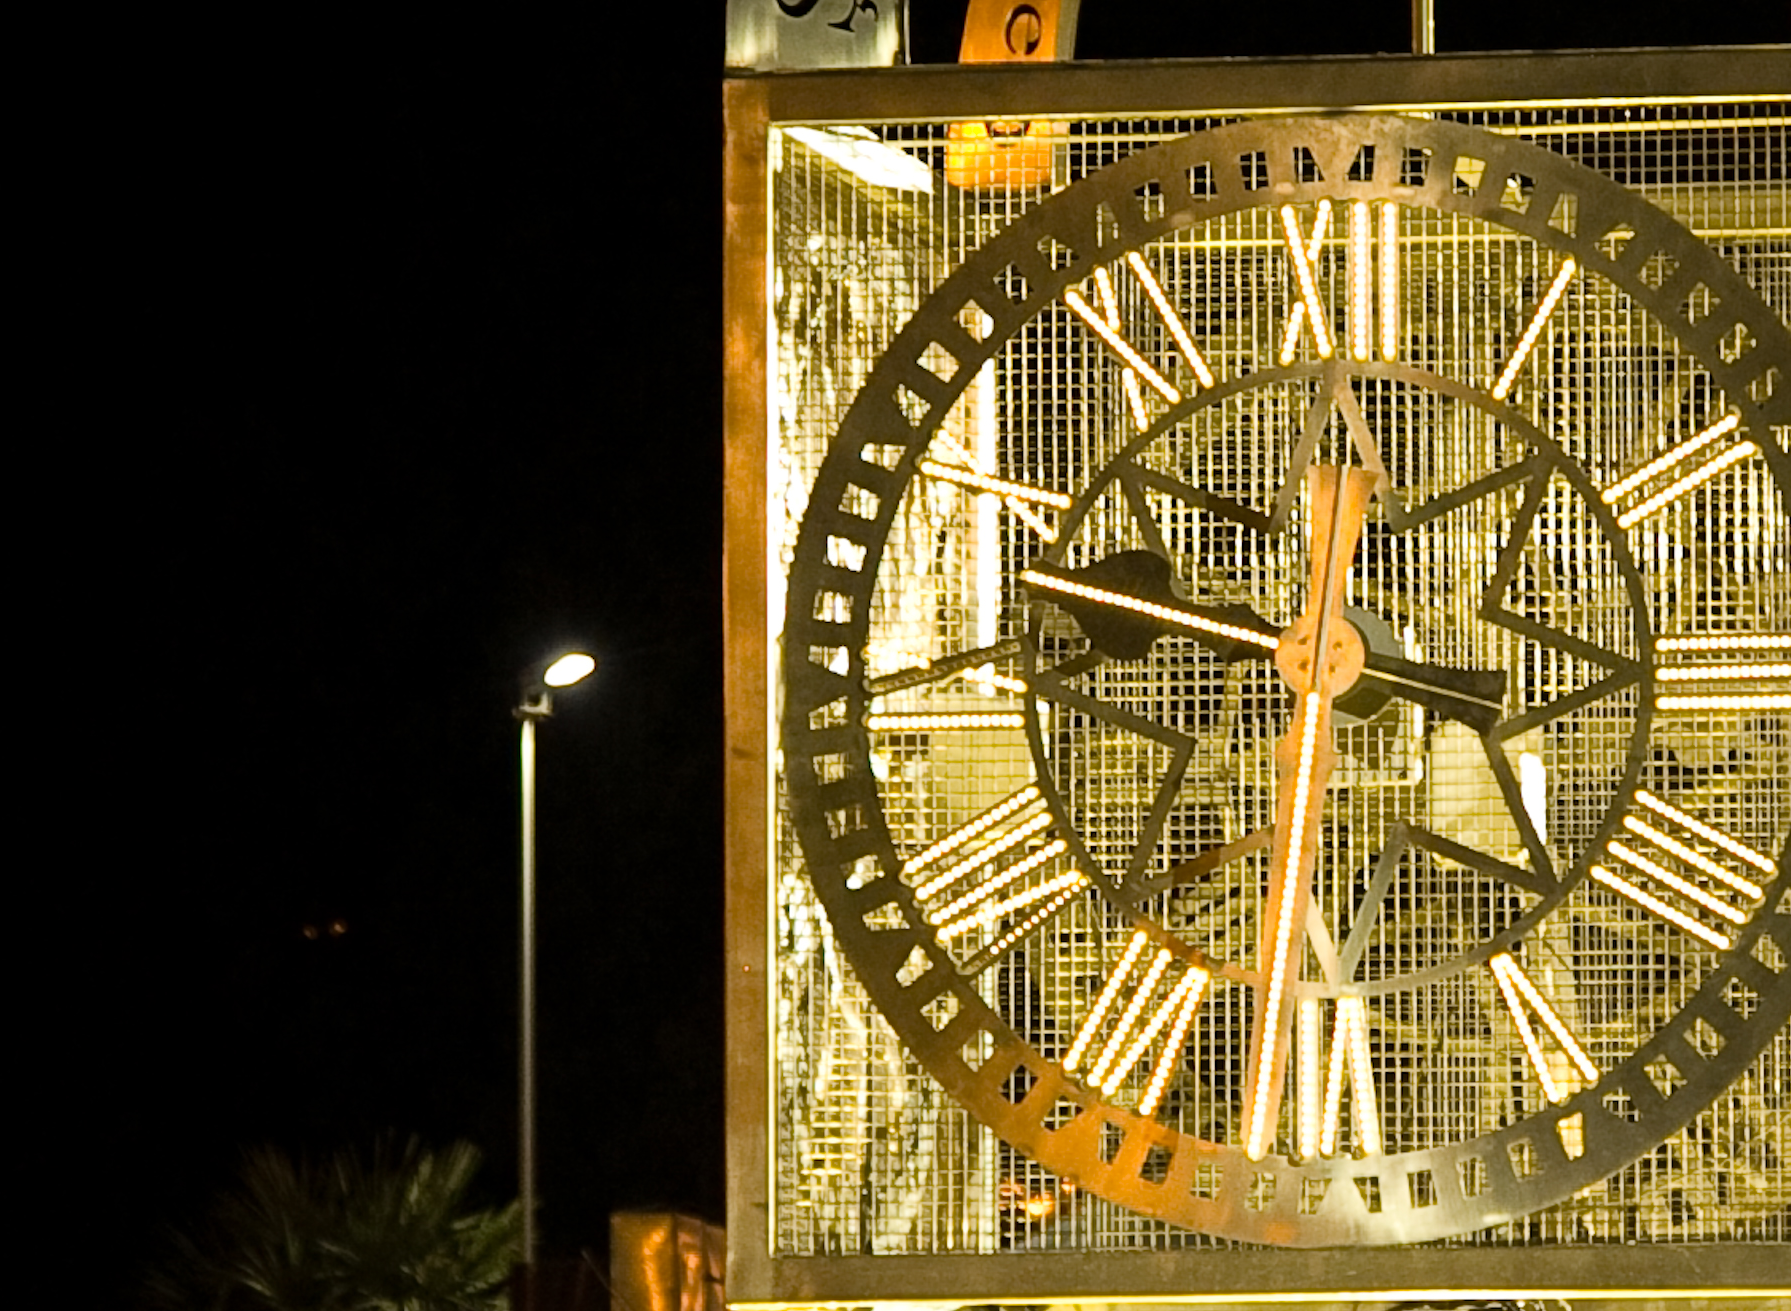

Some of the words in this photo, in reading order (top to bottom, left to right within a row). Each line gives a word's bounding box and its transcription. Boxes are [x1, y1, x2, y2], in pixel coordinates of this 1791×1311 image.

[1064, 250, 1216, 433] XI
[1278, 198, 1399, 367] XII
[1601, 410, 1760, 531] II
